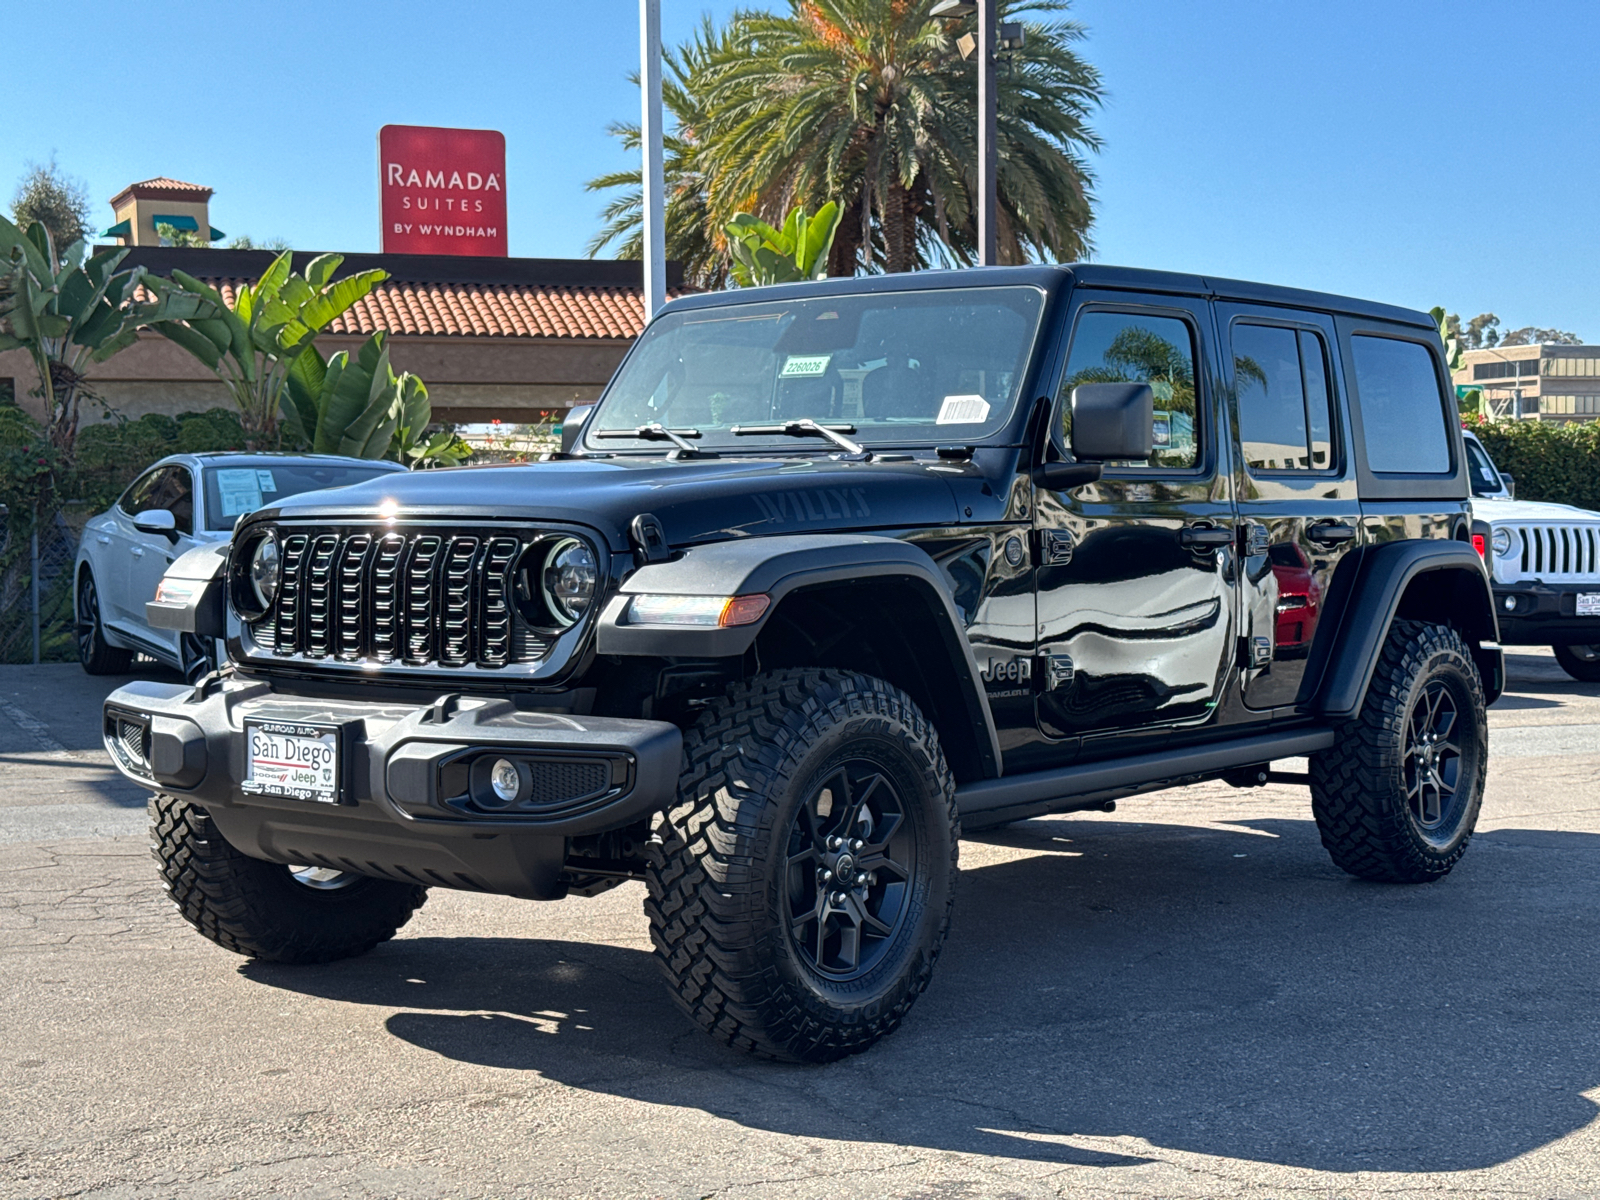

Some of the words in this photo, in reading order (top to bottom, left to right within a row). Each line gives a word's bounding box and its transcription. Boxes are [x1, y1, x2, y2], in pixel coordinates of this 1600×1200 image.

[388, 163, 500, 191] RAMADA
[402, 196, 483, 212] SUITES
[394, 223, 413, 234] BY
[419, 224, 497, 238] WYNDHAM
[786, 361, 822, 373] 2260026
[750, 488, 870, 523] WILLYS
[981, 657, 1029, 684] Jeep
[987, 689, 1022, 699] RANGLER
[263, 723, 295, 735] SUNROAD
[297, 726, 316, 736] AUTO
[253, 735, 279, 758] San
[285, 738, 331, 770] Diego
[291, 769, 316, 786] Jeep
[265, 784, 282, 795] San
[284, 785, 312, 800] Diego
